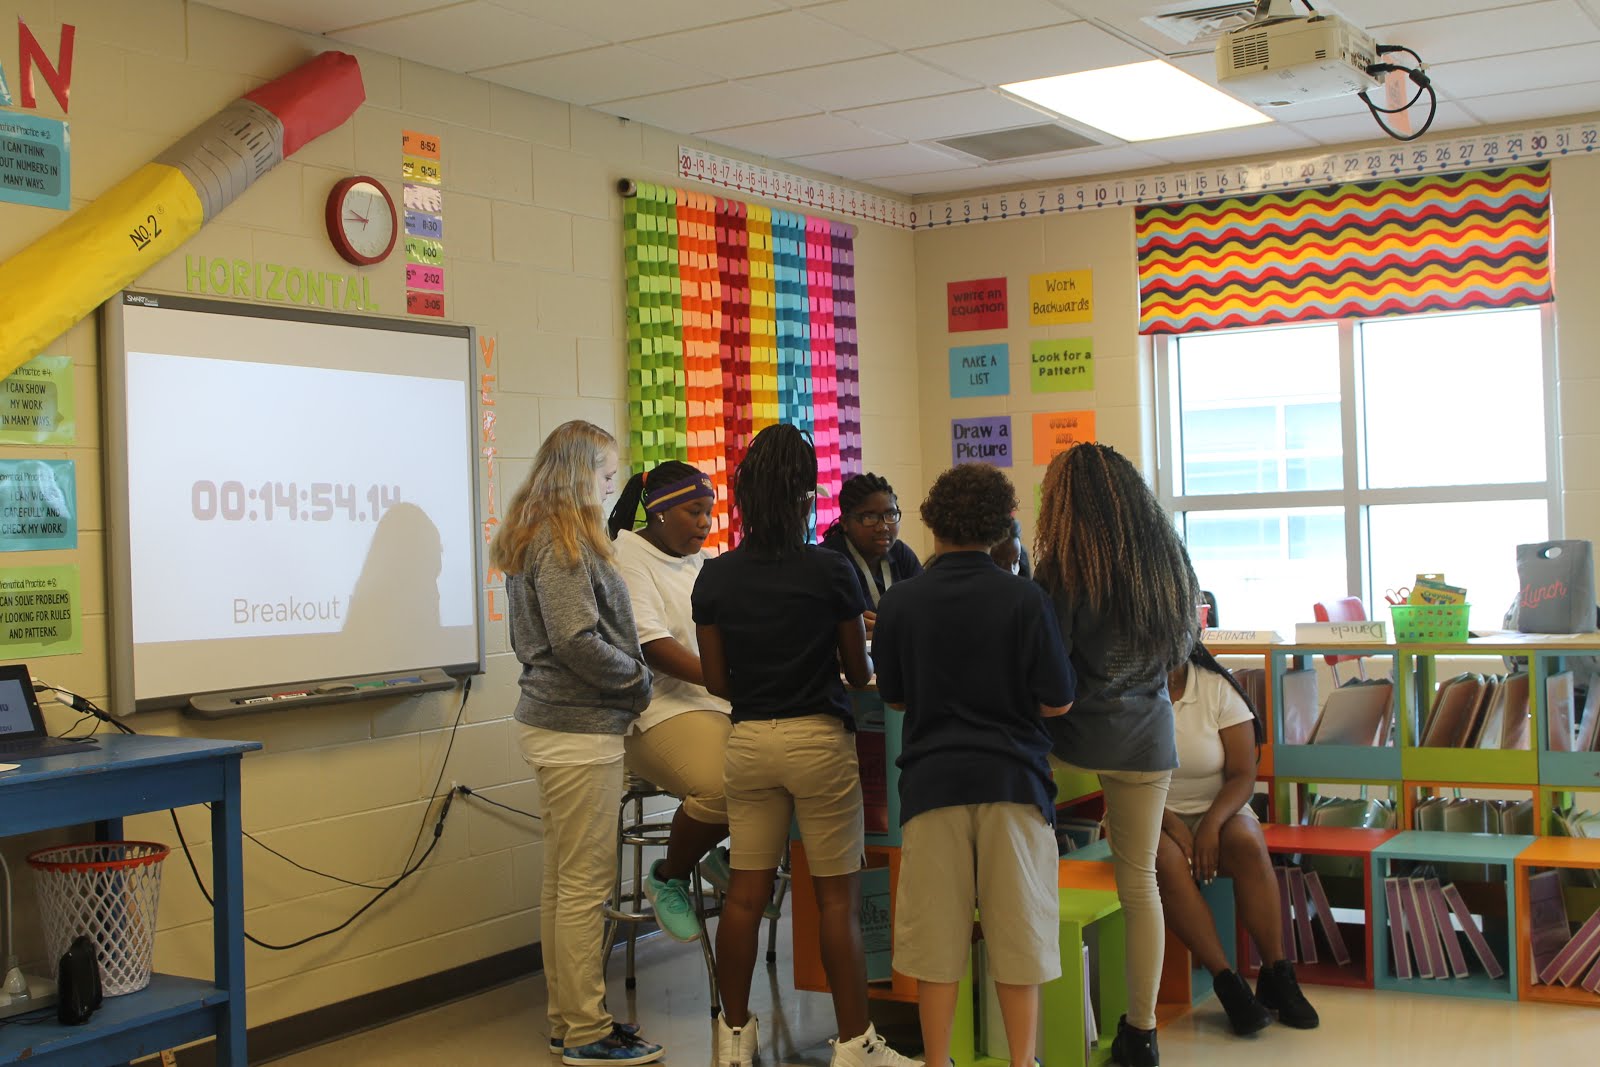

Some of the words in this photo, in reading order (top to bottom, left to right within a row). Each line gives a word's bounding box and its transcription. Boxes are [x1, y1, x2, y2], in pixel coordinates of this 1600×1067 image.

[7, 141, 22, 153] CAN
[24, 144, 45, 158] THINK
[420, 140, 436, 153] 8:52
[16, 160, 49, 175] NUMBERS
[50, 166, 58, 176] IN
[945, 207, 953, 219] 2
[963, 204, 971, 216] 3
[982, 202, 989, 214] 4
[1000, 199, 1008, 212] 5
[1019, 198, 1027, 209] 6
[1039, 195, 1046, 207] 7
[1057, 192, 1065, 205] 8
[1077, 190, 1084, 203] 9
[1095, 188, 1107, 201] 10
[1115, 186, 1125, 199] 11
[1135, 183, 1146, 196] 12
[1155, 181, 1167, 194] 13
[1176, 178, 1187, 192] 14
[1196, 176, 1208, 189] 15
[1216, 173, 1228, 187] 16
[1301, 164, 1315, 177] 20
[1323, 161, 1335, 174] 21
[1345, 158, 1359, 172] 22
[1367, 155, 1382, 169] 23
[1390, 152, 1403, 167] 24
[1413, 150, 1427, 164] 25
[1436, 148, 1451, 161] 26
[1460, 145, 1474, 159] 27
[1483, 142, 1498, 156] 28
[1507, 139, 1523, 153] 29
[1531, 135, 1547, 150] 30
[1556, 133, 1570, 147] 31
[1581, 130, 1597, 144] 32
[3, 174, 23, 186] MANY
[26, 177, 46, 190] WAYS.
[680, 155, 691, 170] -20
[693, 159, 704, 173] -19
[707, 162, 718, 176] -18
[720, 165, 730, 179] -17
[733, 169, 743, 183] -16
[746, 172, 756, 186] -15
[758, 175, 768, 189] -14
[771, 178, 780, 191] -13
[783, 180, 792, 194] -12
[805, 186, 814, 199] -10
[817, 189, 824, 201] -9
[828, 192, 835, 204] -8
[839, 194, 845, 206] -7
[849, 197, 856, 209] -6
[860, 200, 867, 211] -5
[890, 207, 896, 219] -2
[909, 211, 917, 223] 0
[423, 246, 437, 258] 1:00
[185, 254, 380, 312] HORIZONTAL
[406, 270, 416, 281] 5th
[424, 273, 440, 284] 2:02
[1045, 278, 1076, 292] Work
[953, 290, 984, 303] WRITE
[1033, 298, 1090, 315] Backwards
[962, 355, 987, 368] MAKE
[991, 355, 997, 367] A
[1032, 352, 1061, 364] Look
[1063, 350, 1082, 361] for
[1084, 351, 1092, 360] a
[1039, 365, 1086, 377] Pattern
[970, 372, 990, 385] LIST
[10, 382, 24, 393] CAN
[26, 383, 46, 395] SHOW
[10, 399, 20, 409] MY
[22, 399, 43, 410] WORK
[2, 414, 10, 425] IN
[11, 415, 30, 426] MANY
[953, 423, 993, 440] Draw
[999, 424, 1009, 437] a
[956, 443, 1008, 459] Picture
[4, 507, 45, 518] CAREFULLY
[47, 507, 61, 518] AND
[2, 523, 27, 535] CHECK
[28, 523, 39, 534] MY
[26, 579, 46, 588] Practice
[0, 595, 13, 607] CAN
[15, 595, 34, 606] SOLVE
[36, 593, 69, 605] PROBLEMS
[1519, 580, 1568, 609] Lunch
[5, 611, 35, 623] LOOKING
[36, 610, 50, 621] FOR
[50, 609, 71, 620] RULES
[233, 595, 341, 624] Breakout
[9, 628, 24, 639] AND
[25, 626, 58, 638] PATTERNS.
[1331, 623, 1383, 639] Daniela
